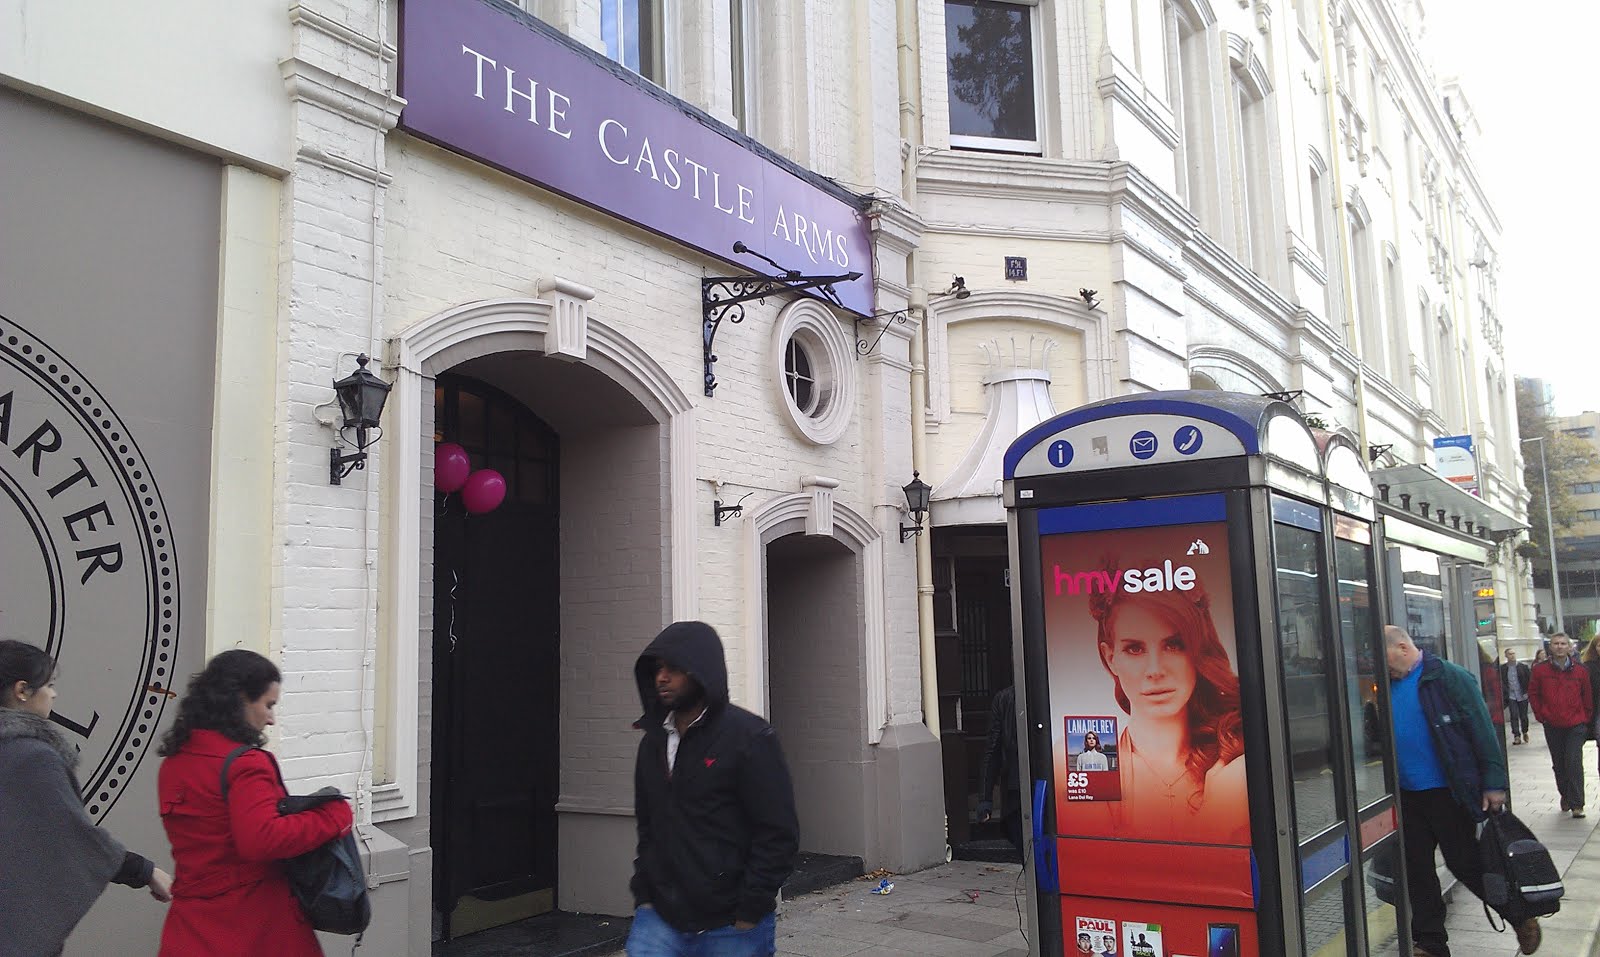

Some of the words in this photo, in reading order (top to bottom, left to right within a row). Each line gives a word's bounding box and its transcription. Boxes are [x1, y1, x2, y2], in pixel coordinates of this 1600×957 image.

[462, 44, 572, 140] THE
[598, 118, 755, 225] CASTLE
[772, 204, 849, 269] ARMS
[1067, 772, 1089, 788] £5
[1079, 919, 1113, 932] PAUL
